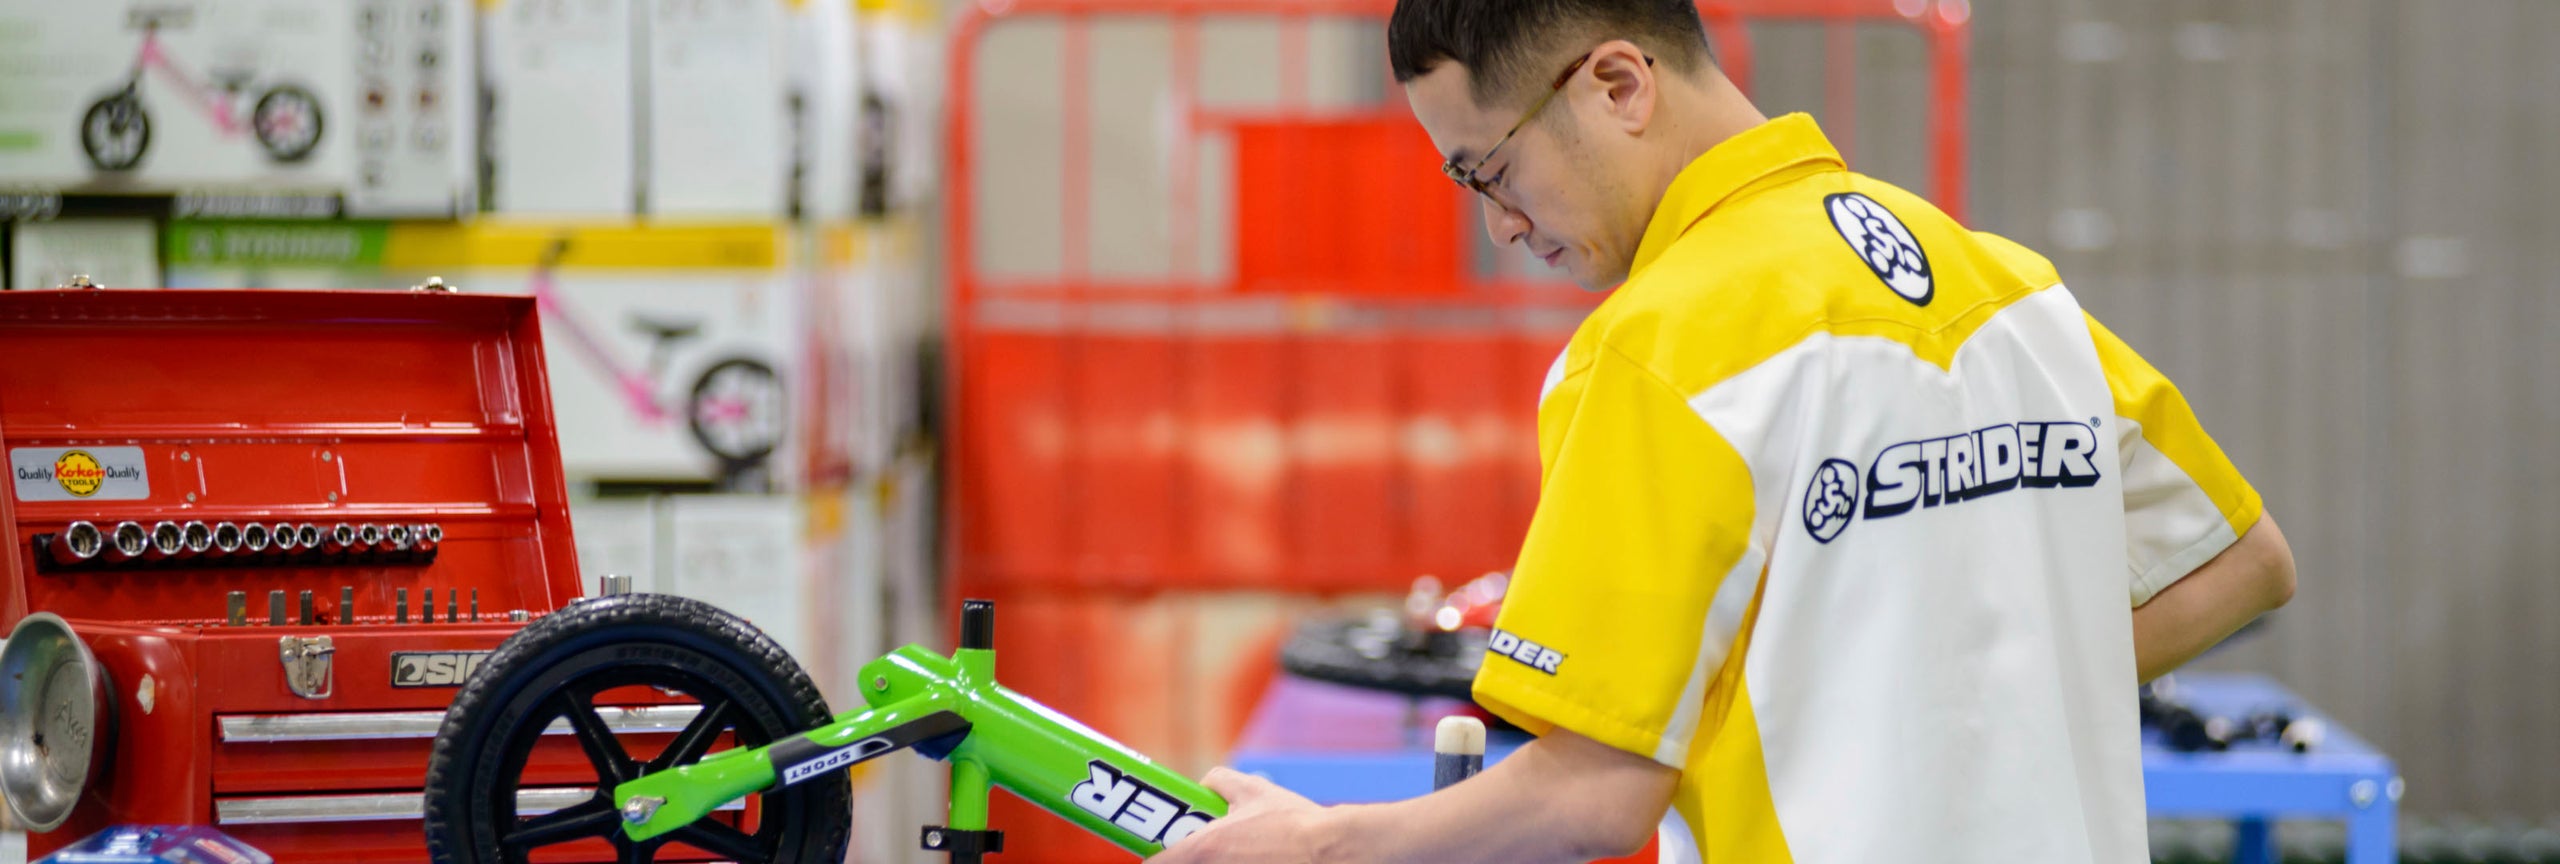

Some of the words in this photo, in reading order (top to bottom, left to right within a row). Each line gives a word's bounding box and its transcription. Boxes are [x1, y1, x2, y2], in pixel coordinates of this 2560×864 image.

[18, 467, 53, 482] Quality
[54, 462, 106, 479] Koken
[107, 465, 141, 481] Quality
[790, 751, 852, 780] SPORT
